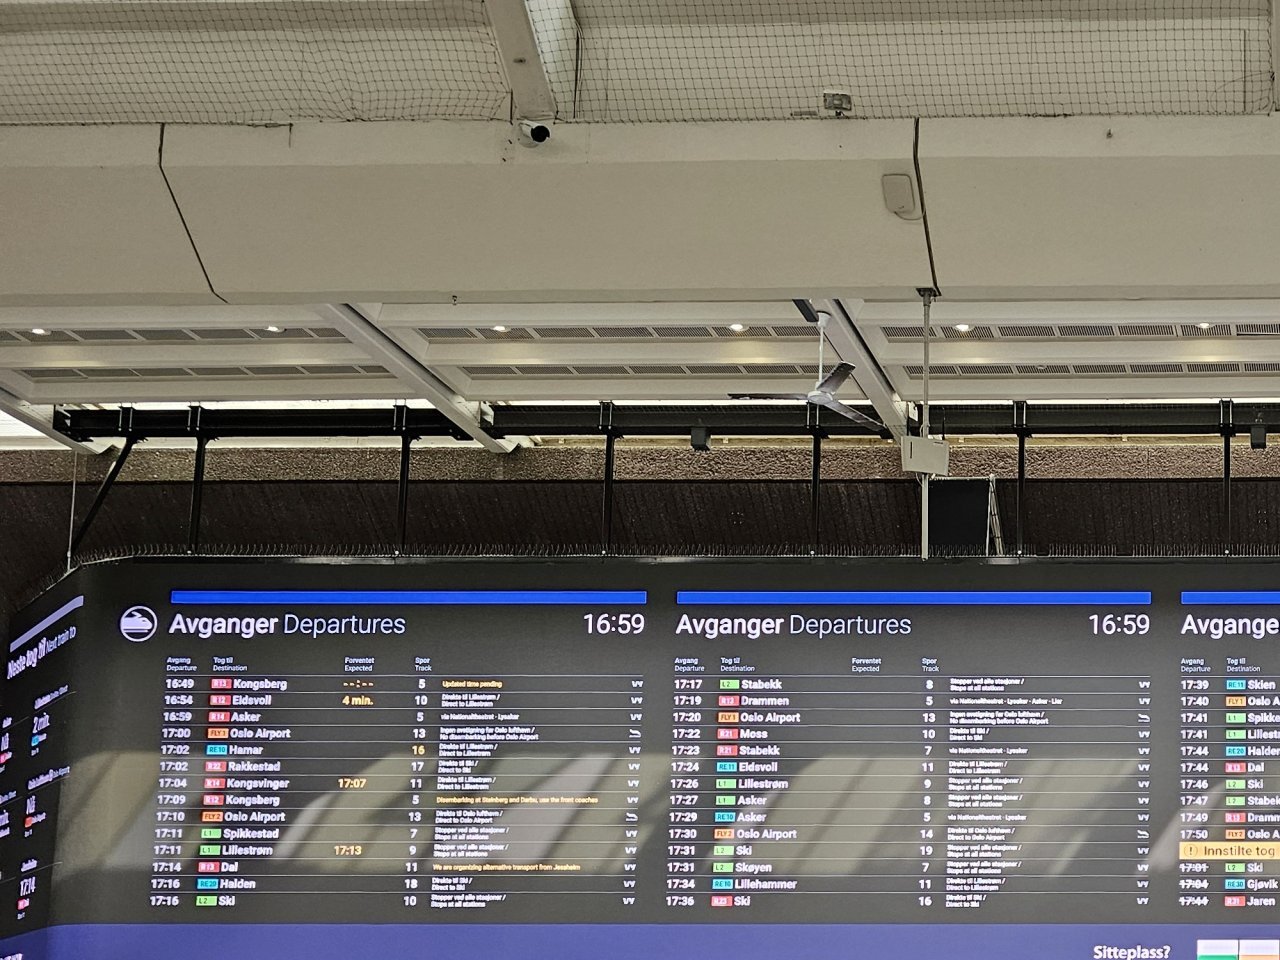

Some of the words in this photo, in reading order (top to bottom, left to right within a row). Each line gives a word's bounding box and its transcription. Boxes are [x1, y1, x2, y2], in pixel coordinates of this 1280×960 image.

[169, 612, 278, 638] Avganger
[283, 613, 406, 638] Departures
[582, 613, 645, 634] 16:59
[676, 613, 784, 638] Avganger
[790, 613, 911, 638] Departures
[1088, 614, 1150, 635] 16:59
[7, 655, 26, 680] Neste
[26, 647, 38, 667] tog
[674, 665, 705, 673] Departure
[852, 665, 880, 673] Expected
[166, 679, 194, 689] 16:49
[233, 679, 287, 690] Kongsberg
[674, 680, 702, 689] 17:17
[742, 680, 782, 689] Stabekk
[1248, 680, 1276, 690] Skien
[164, 696, 194, 705] 16:54
[342, 696, 349, 705] 4
[351, 696, 374, 705] min.
[414, 696, 428, 706] 10
[674, 696, 702, 705] 17:19
[741, 696, 789, 706] Drammen
[163, 712, 192, 722] 16:59
[231, 712, 261, 722] Asker
[162, 729, 190, 738] 17:00
[230, 728, 254, 738] Oslo
[256, 728, 291, 740] Airport
[672, 729, 700, 739] 17:22
[740, 729, 768, 739] Moss
[161, 745, 190, 755] 17:02
[230, 745, 263, 755] Hamar
[412, 746, 425, 756] 16
[1204, 846, 1253, 856] Innstilte
[1256, 846, 1276, 858] tog
[667, 879, 696, 889] 17:34
[735, 879, 798, 889] Lillehammer
